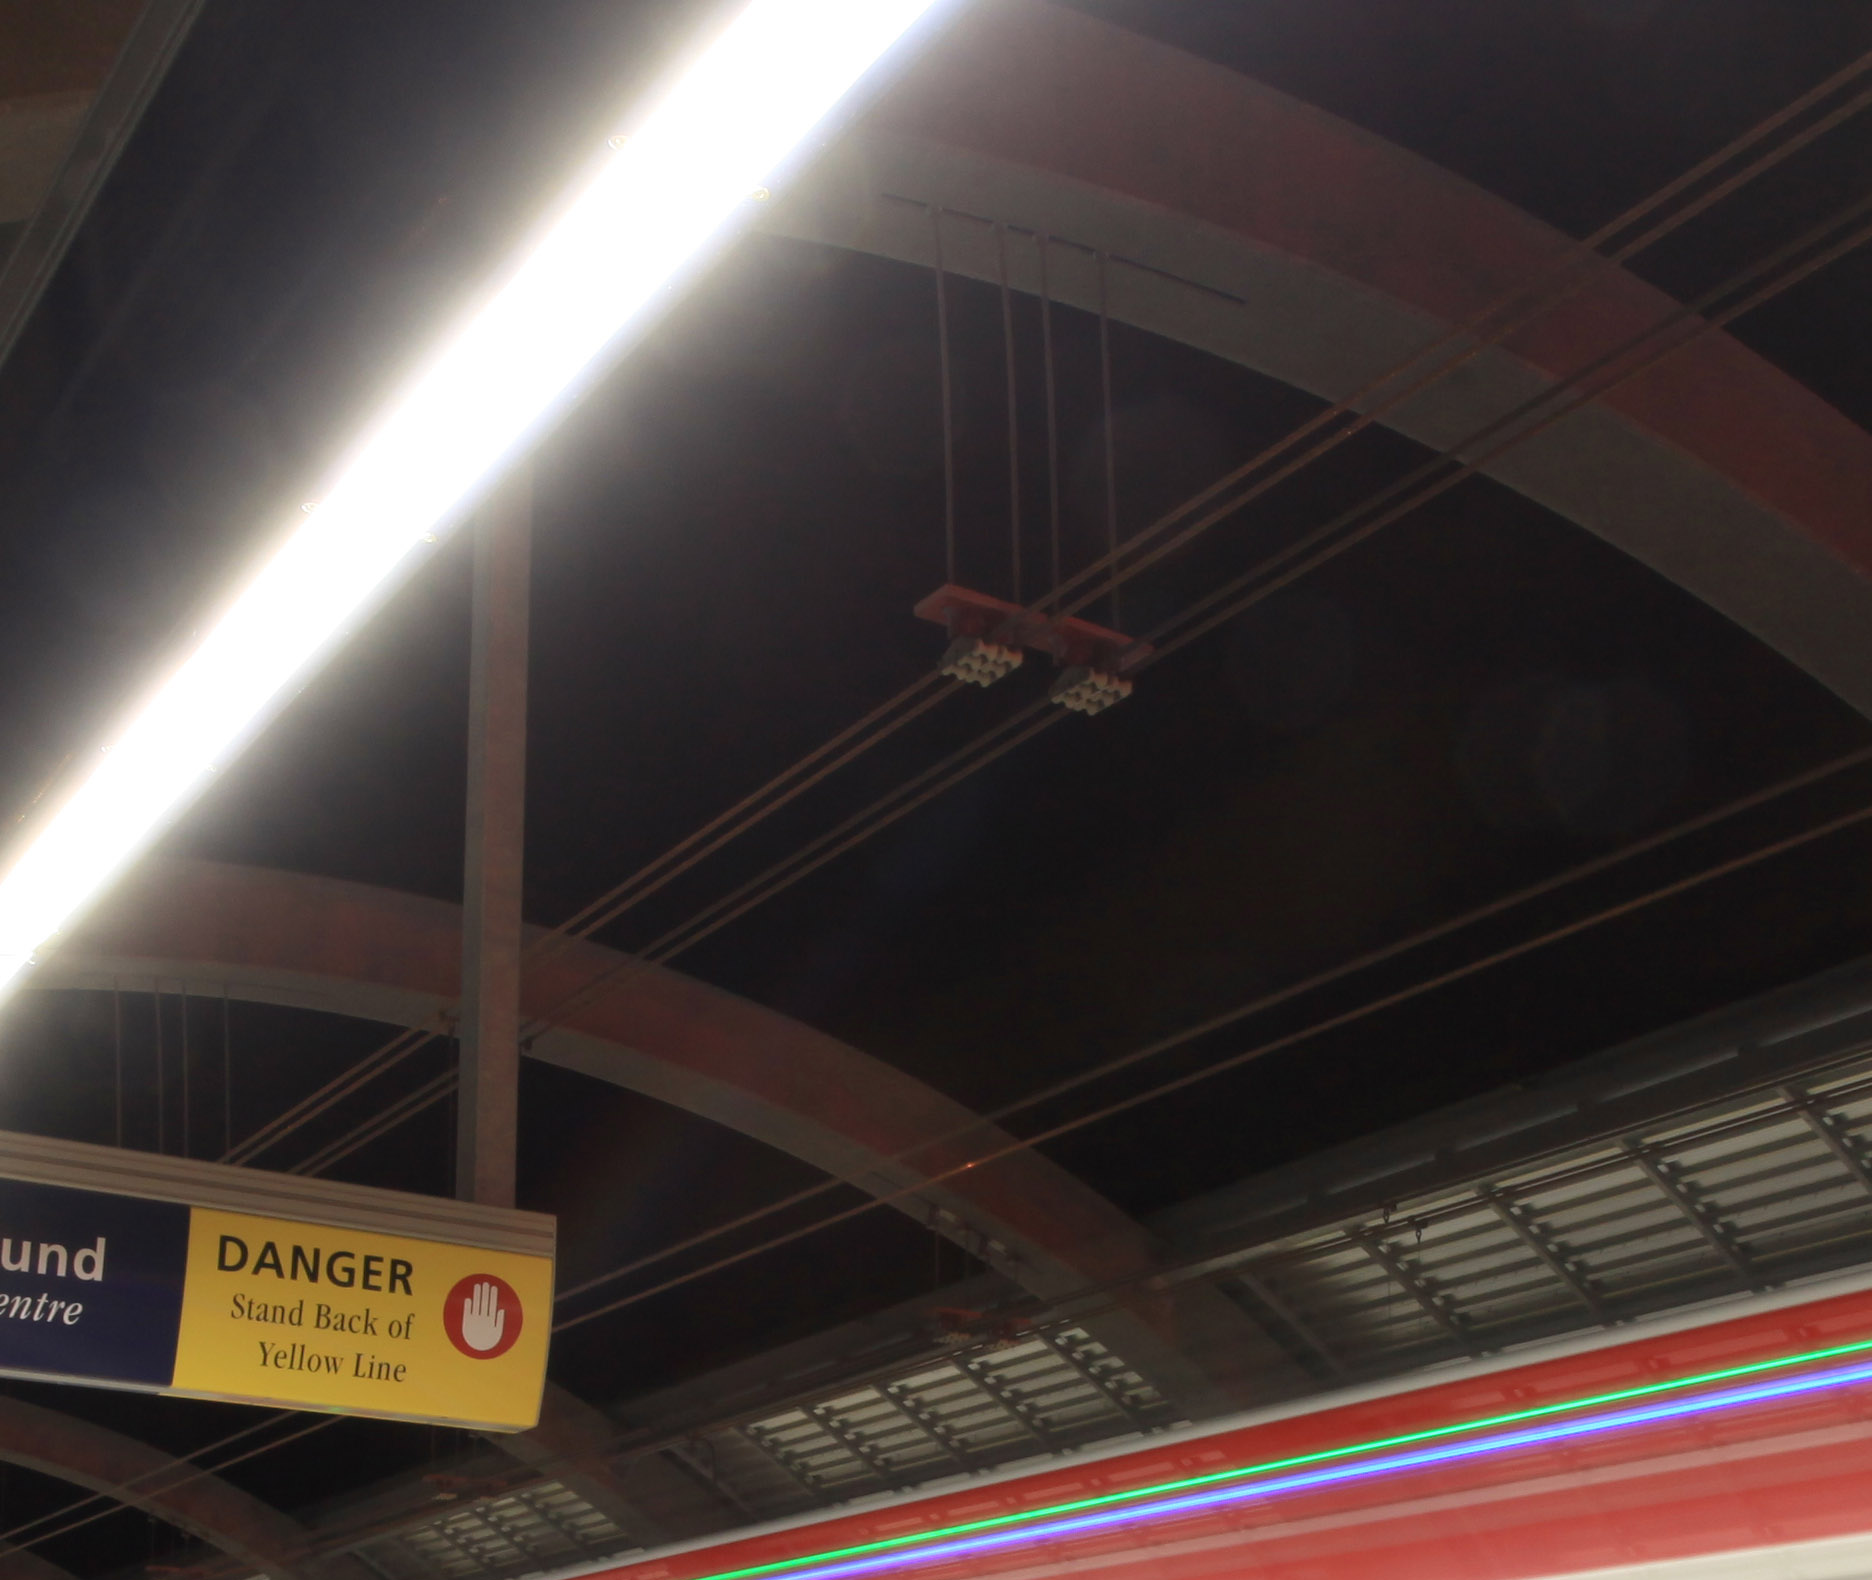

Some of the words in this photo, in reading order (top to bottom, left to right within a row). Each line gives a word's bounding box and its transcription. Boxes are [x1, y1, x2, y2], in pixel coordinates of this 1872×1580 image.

[217, 1234, 414, 1296] DANGER
[230, 1293, 305, 1327] Stand
[314, 1303, 378, 1336] Back
[388, 1313, 416, 1340] of
[258, 1341, 344, 1375] Yellow
[352, 1353, 407, 1383] Line
